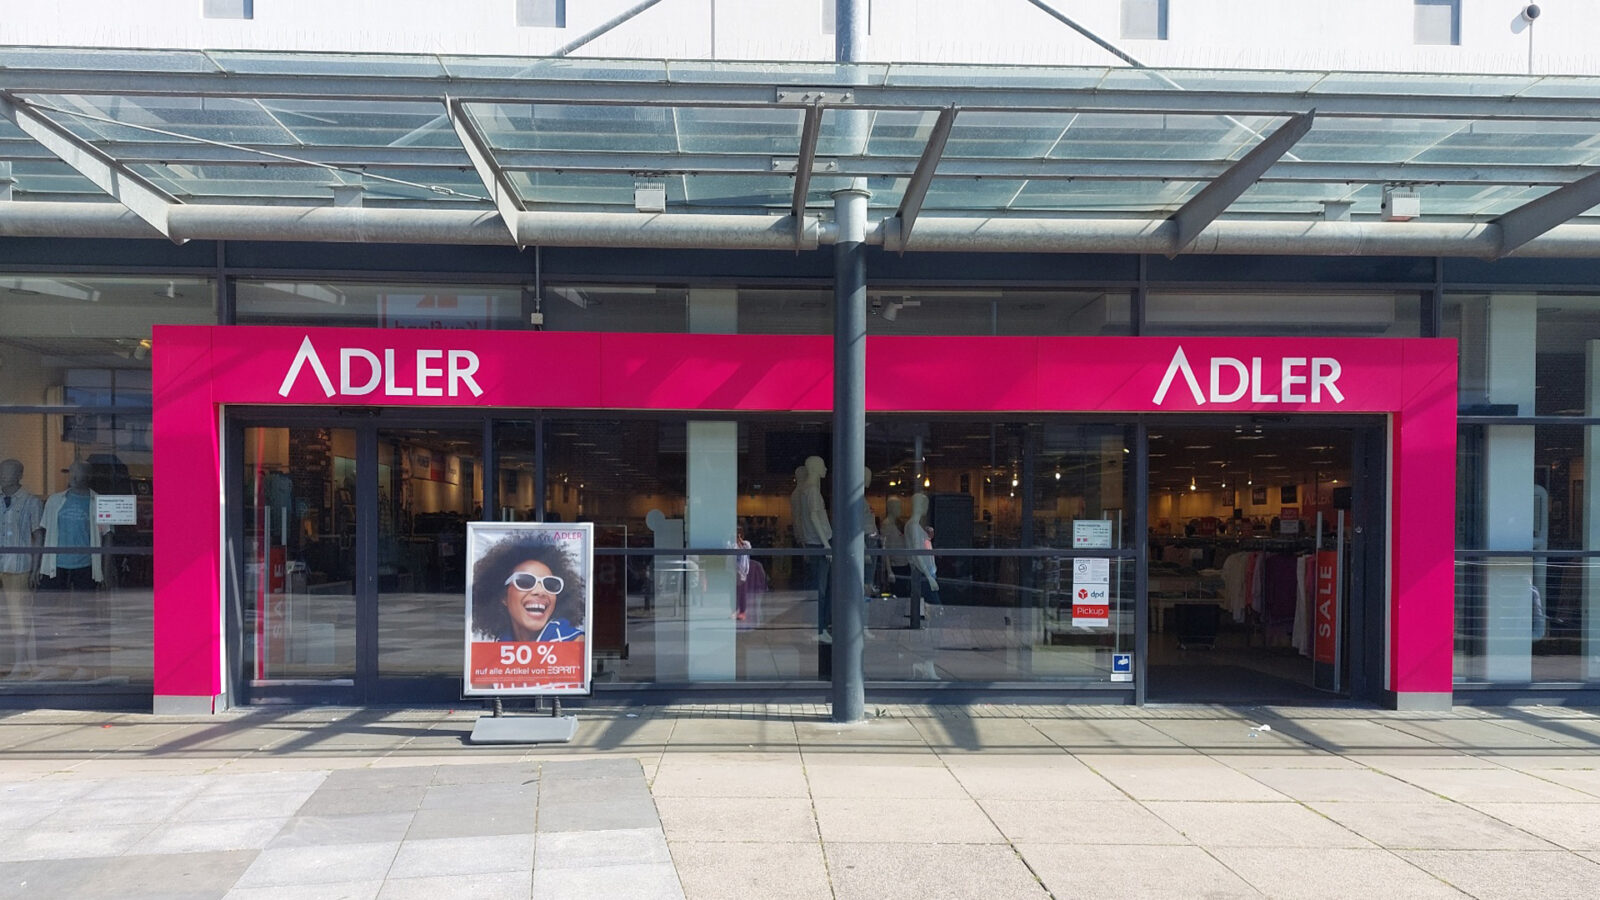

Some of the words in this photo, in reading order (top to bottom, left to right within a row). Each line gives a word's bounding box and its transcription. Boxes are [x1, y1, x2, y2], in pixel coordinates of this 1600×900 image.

[278, 335, 484, 398] ADLER
[1152, 345, 1345, 405] ADLER
[553, 531, 582, 540] ADLER
[1091, 590, 1104, 598] dpd
[1319, 566, 1332, 638] SALE
[1076, 607, 1105, 616] Pickup
[500, 645, 532, 664] 50
[537, 645, 557, 664] %
[475, 667, 487, 675] auf
[489, 667, 502, 675] alle
[504, 667, 530, 675] Artikel
